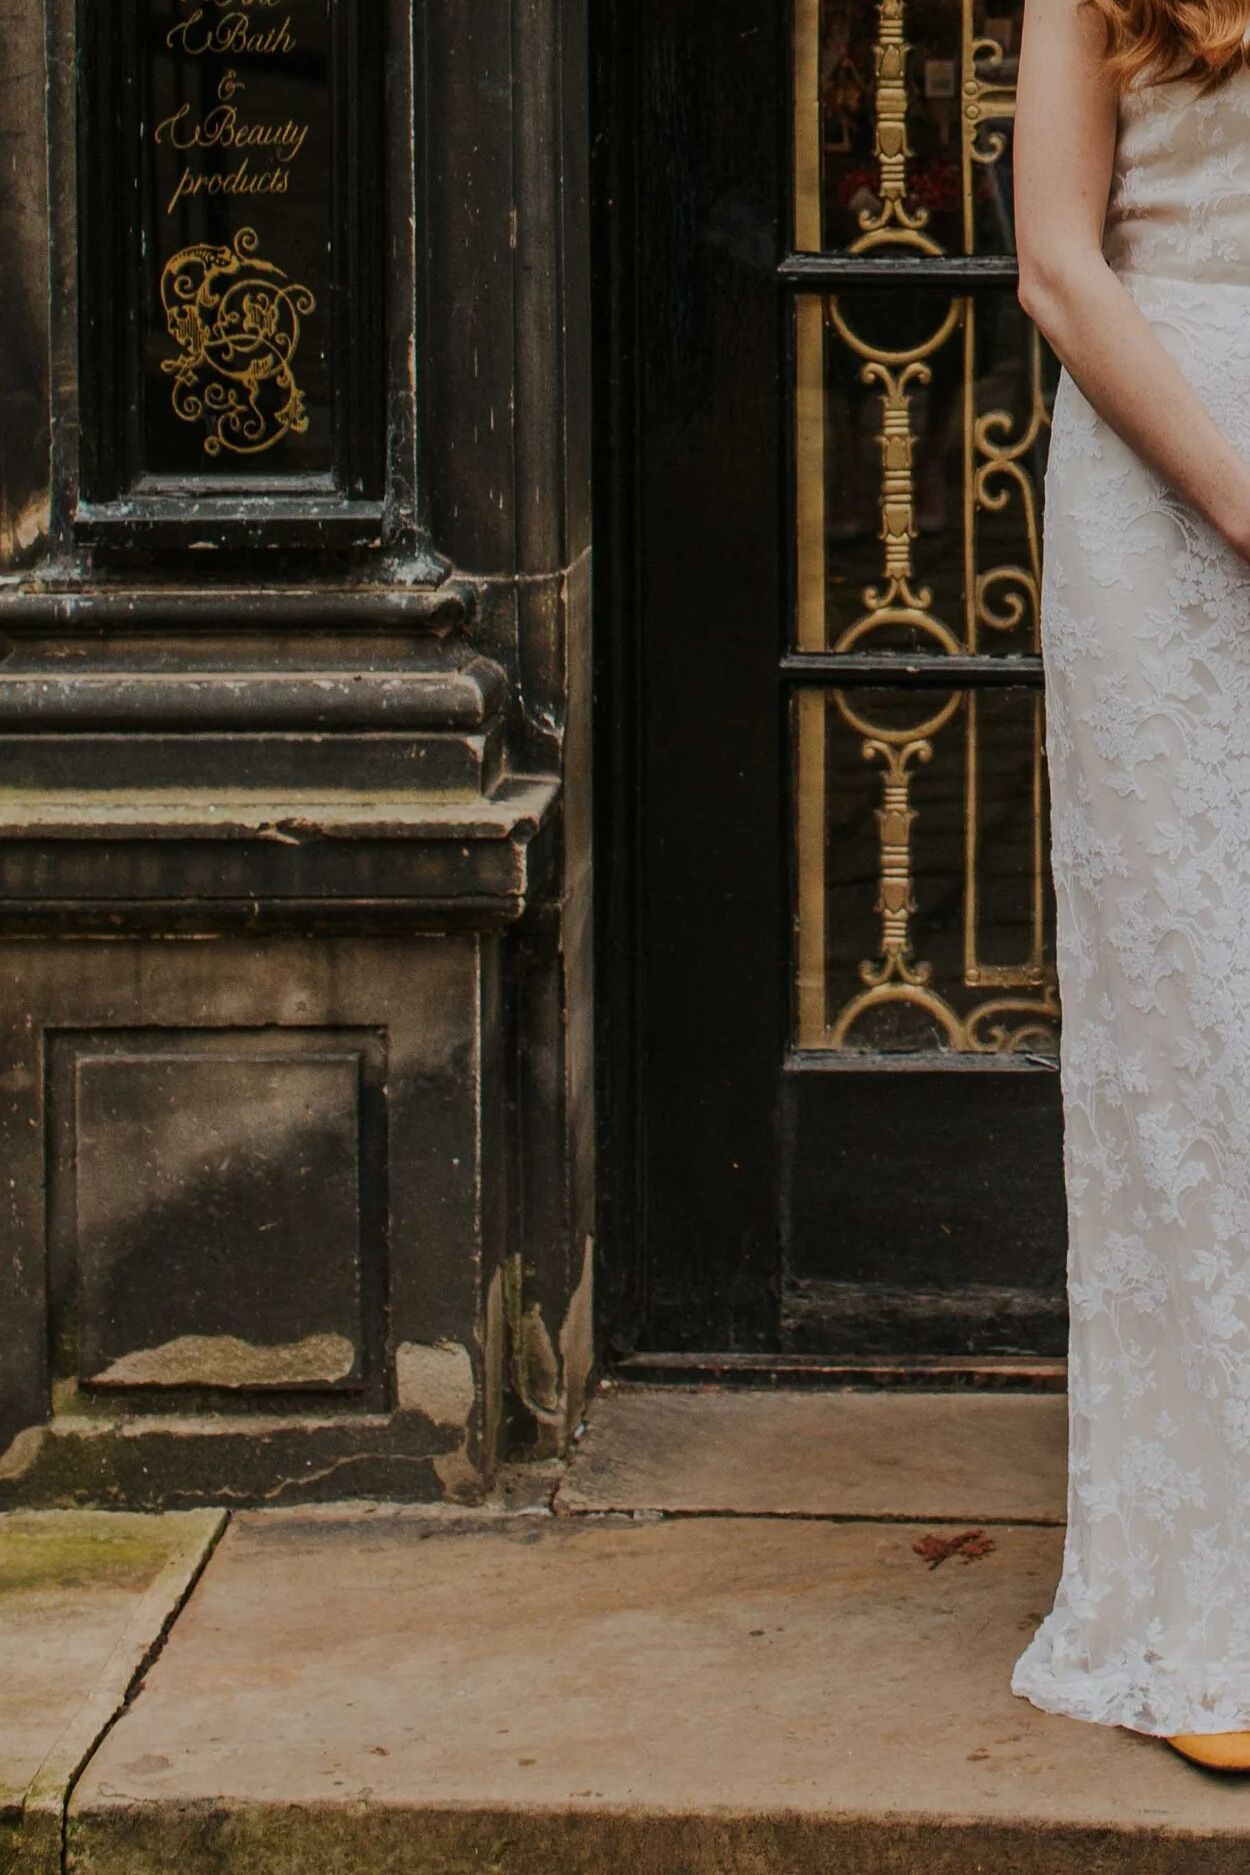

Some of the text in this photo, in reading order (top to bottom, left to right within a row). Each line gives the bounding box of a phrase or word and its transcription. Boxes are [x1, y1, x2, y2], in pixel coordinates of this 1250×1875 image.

[166, 9, 297, 55] Bath
[218, 69, 245, 101] &
[155, 103, 309, 162] Beauty
[167, 158, 290, 215] products
